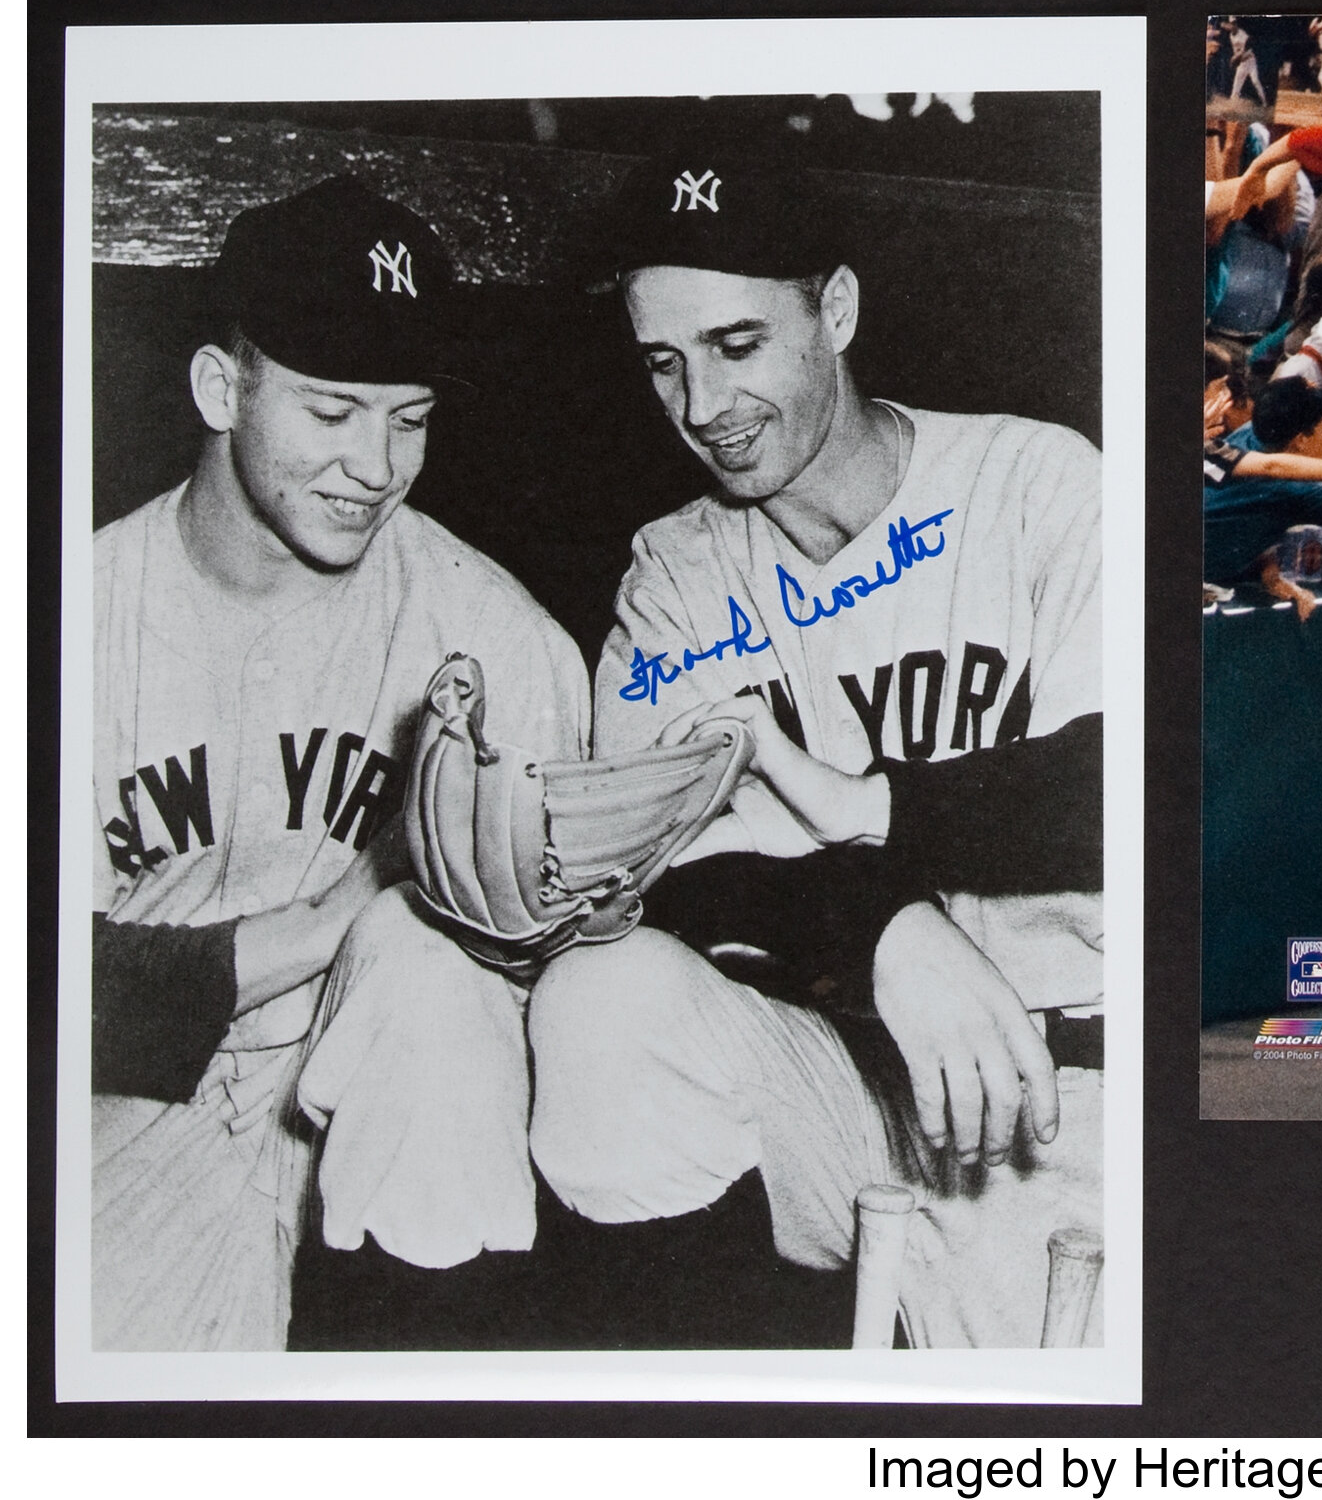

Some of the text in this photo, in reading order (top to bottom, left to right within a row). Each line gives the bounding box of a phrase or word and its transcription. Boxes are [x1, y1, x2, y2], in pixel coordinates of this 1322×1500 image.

[618, 595, 772, 706] Frank
[1254, 1035, 1302, 1045] Photo
[1263, 1051, 1285, 1060] 2004
[1286, 1050, 1312, 1060] Photo
